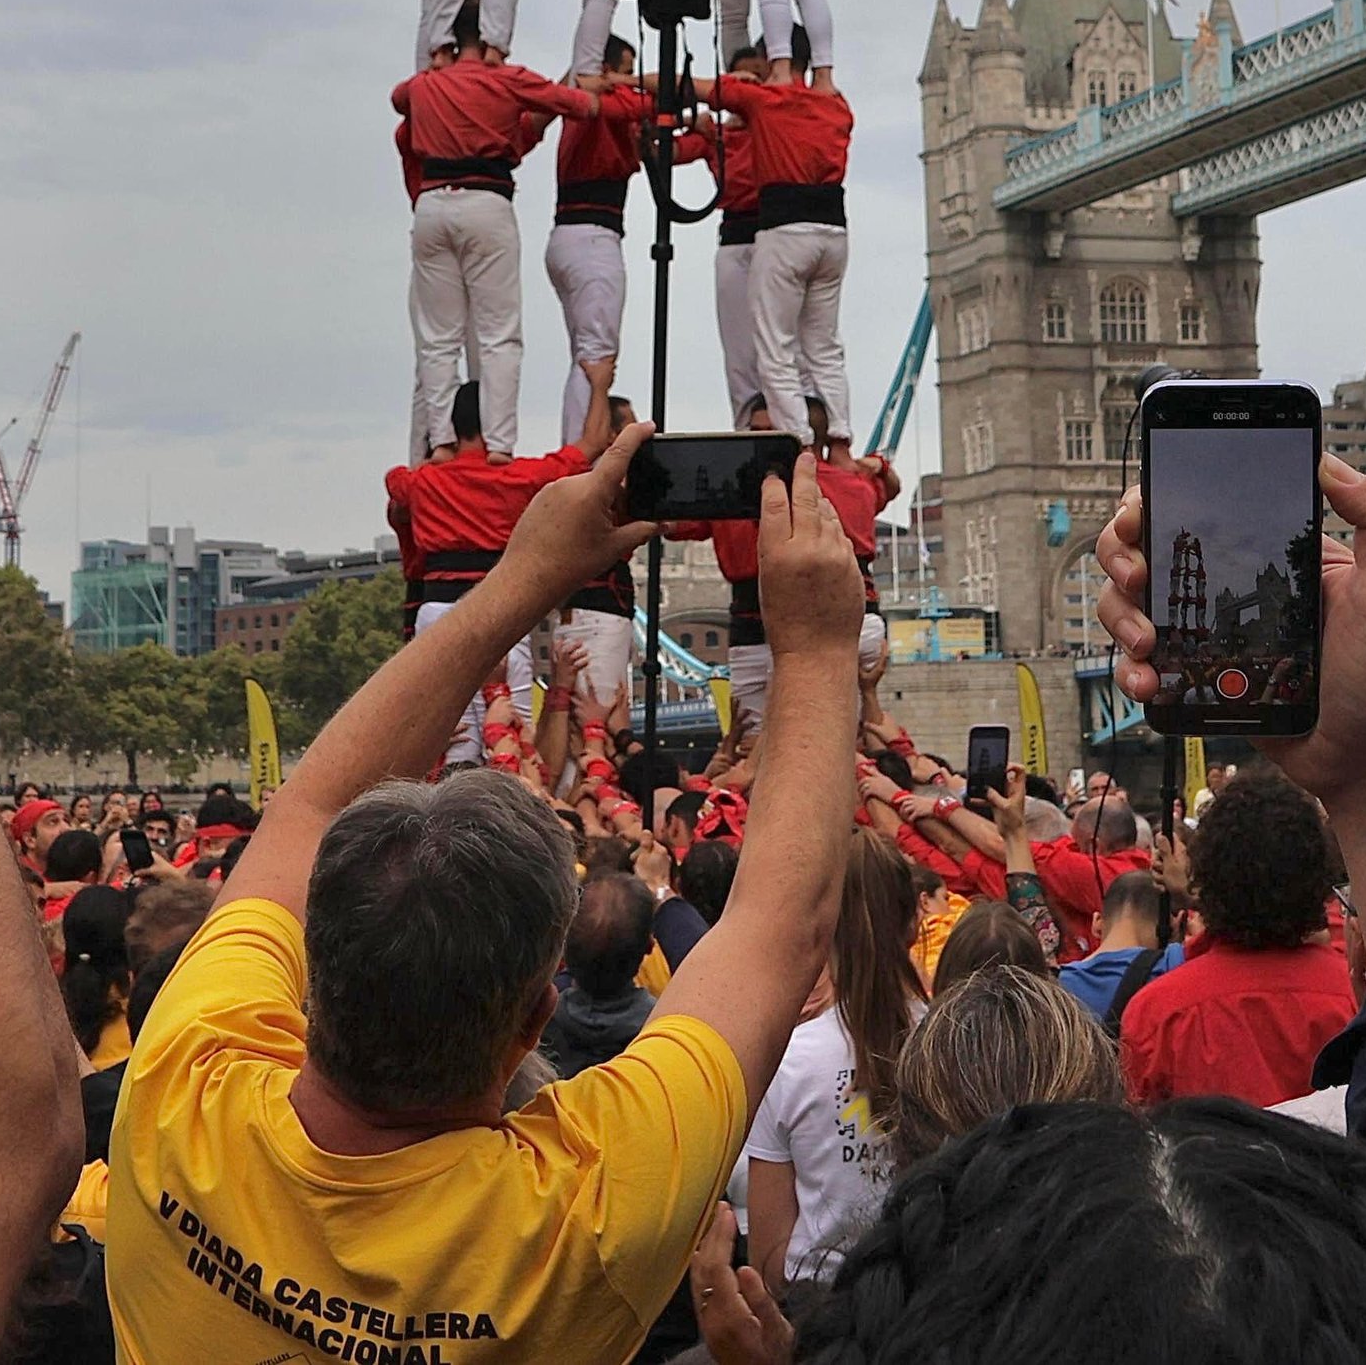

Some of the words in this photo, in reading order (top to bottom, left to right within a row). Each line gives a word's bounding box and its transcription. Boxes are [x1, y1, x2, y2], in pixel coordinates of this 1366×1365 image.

[1212, 412, 1250, 420] 00:00:00
[159, 1190, 180, 1221] V
[178, 1208, 264, 1294] DIADA
[273, 1278, 500, 1342] CASTELLERA
[186, 1246, 452, 1365] INTERNACIONAL
